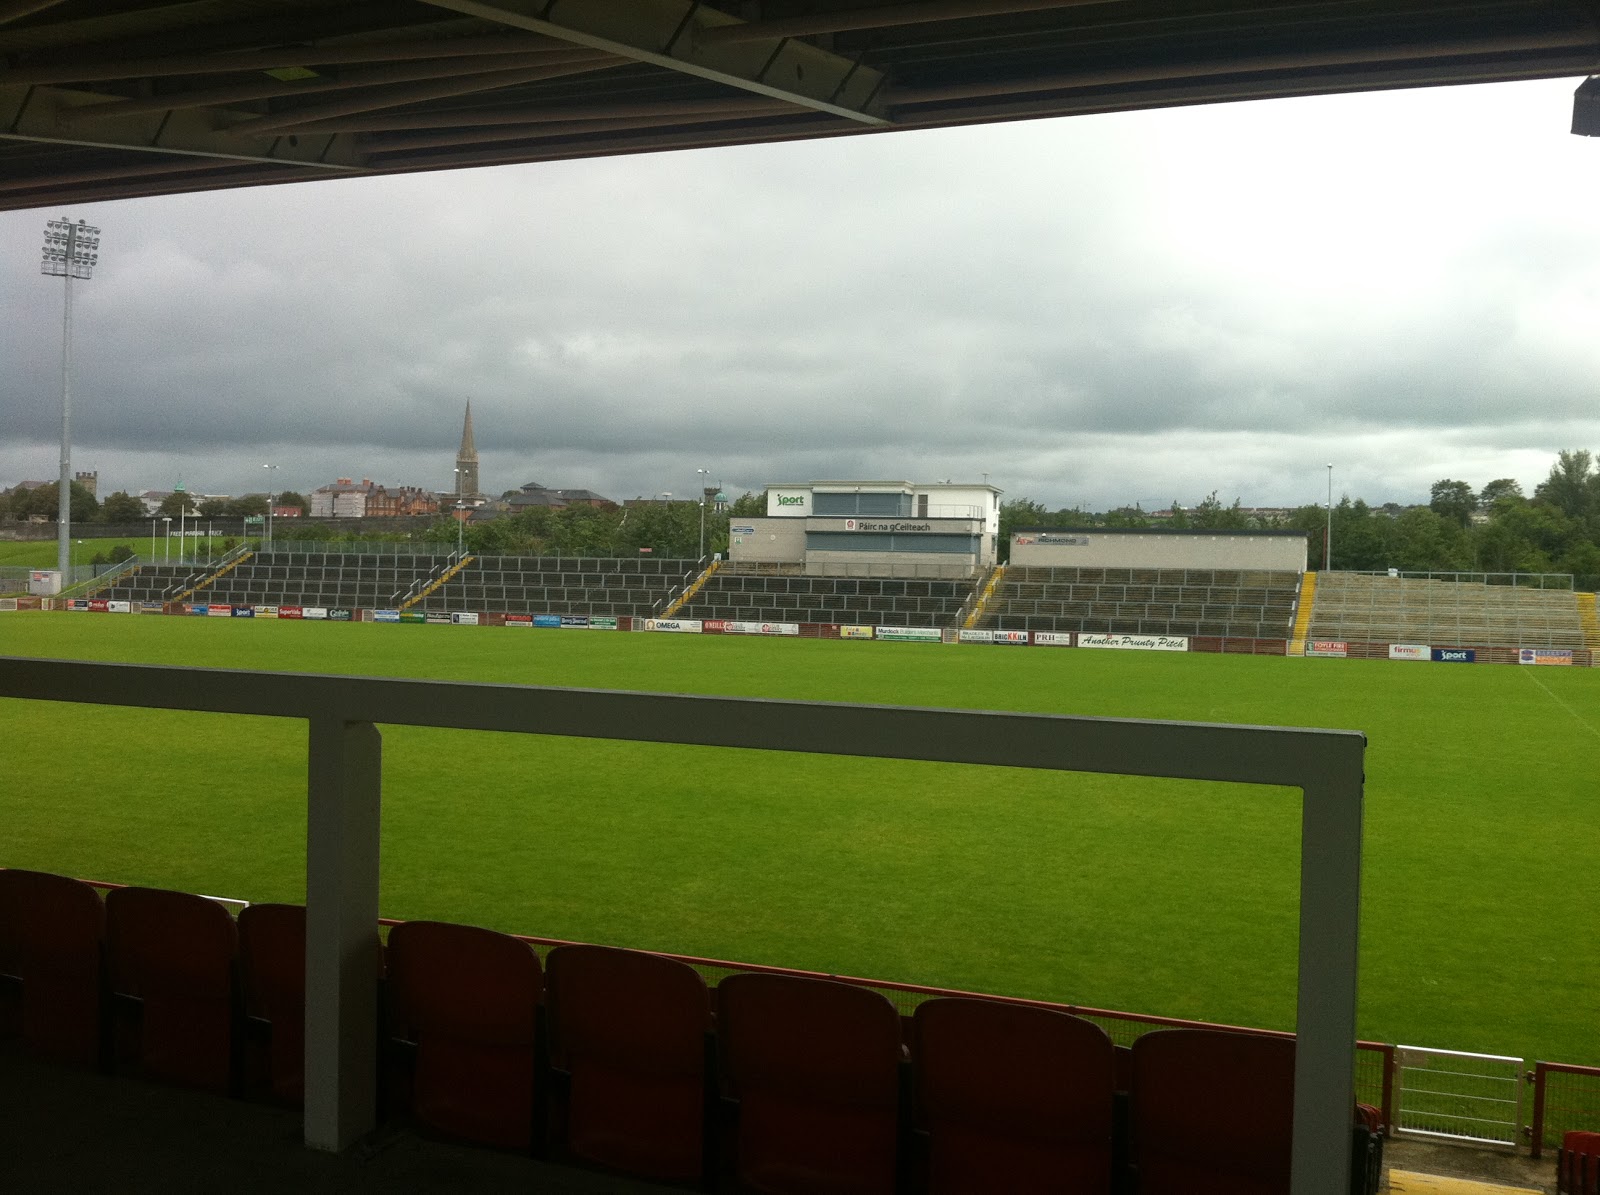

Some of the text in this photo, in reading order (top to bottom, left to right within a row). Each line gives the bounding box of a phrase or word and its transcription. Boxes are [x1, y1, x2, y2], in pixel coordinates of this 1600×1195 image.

[858, 522, 877, 530] Páirc
[890, 523, 930, 532] gCeilteach
[994, 632, 1026, 640] BRICKKILN
[1081, 636, 1184, 648] Another Prunty Pitch
